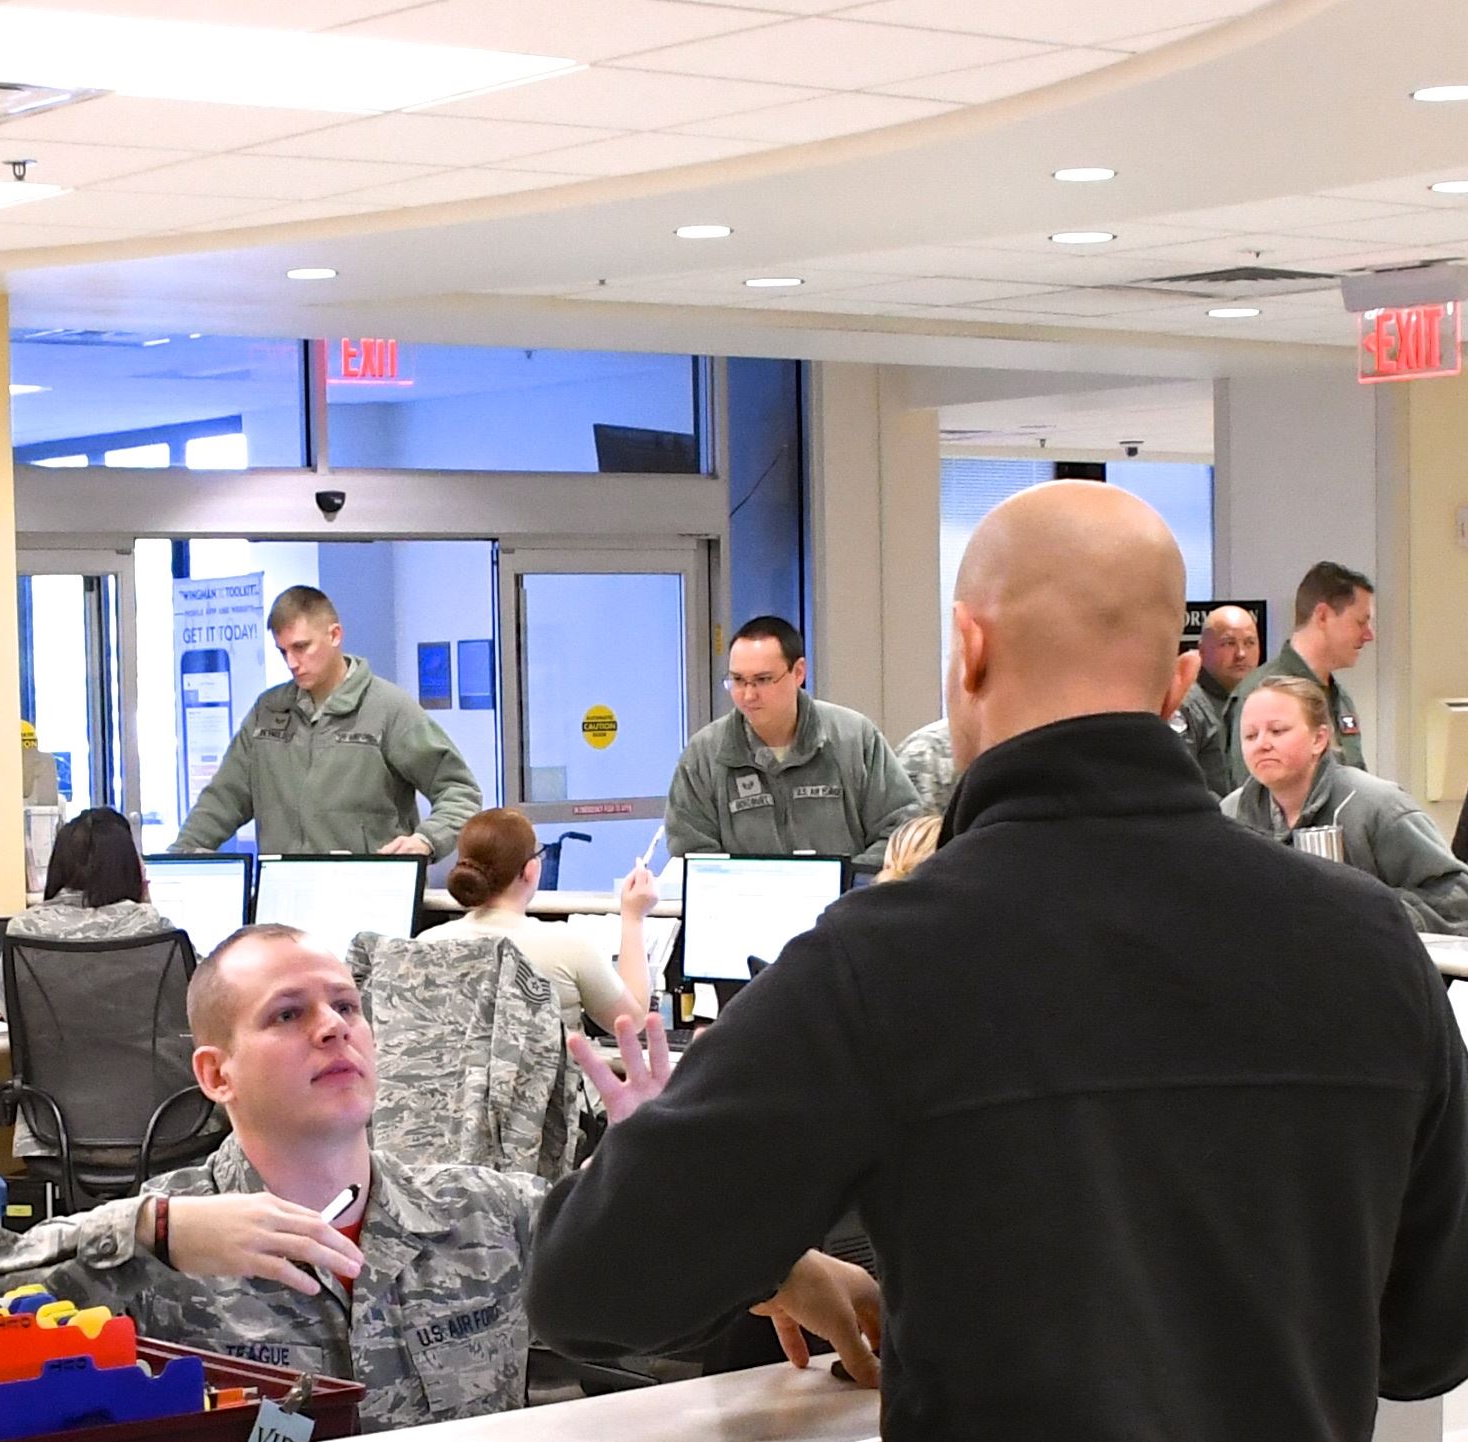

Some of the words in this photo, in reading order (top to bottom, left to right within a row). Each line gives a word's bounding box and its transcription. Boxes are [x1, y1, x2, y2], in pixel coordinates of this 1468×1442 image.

[1375, 304, 1445, 373] EXIT
[183, 627, 202, 644] GET
[206, 626, 215, 642] IT
[218, 623, 258, 642] TODAY!
[584, 721, 616, 730] CAUTION
[448, 1314, 474, 1338] AIR
[226, 1345, 291, 1366] TEAGUE
